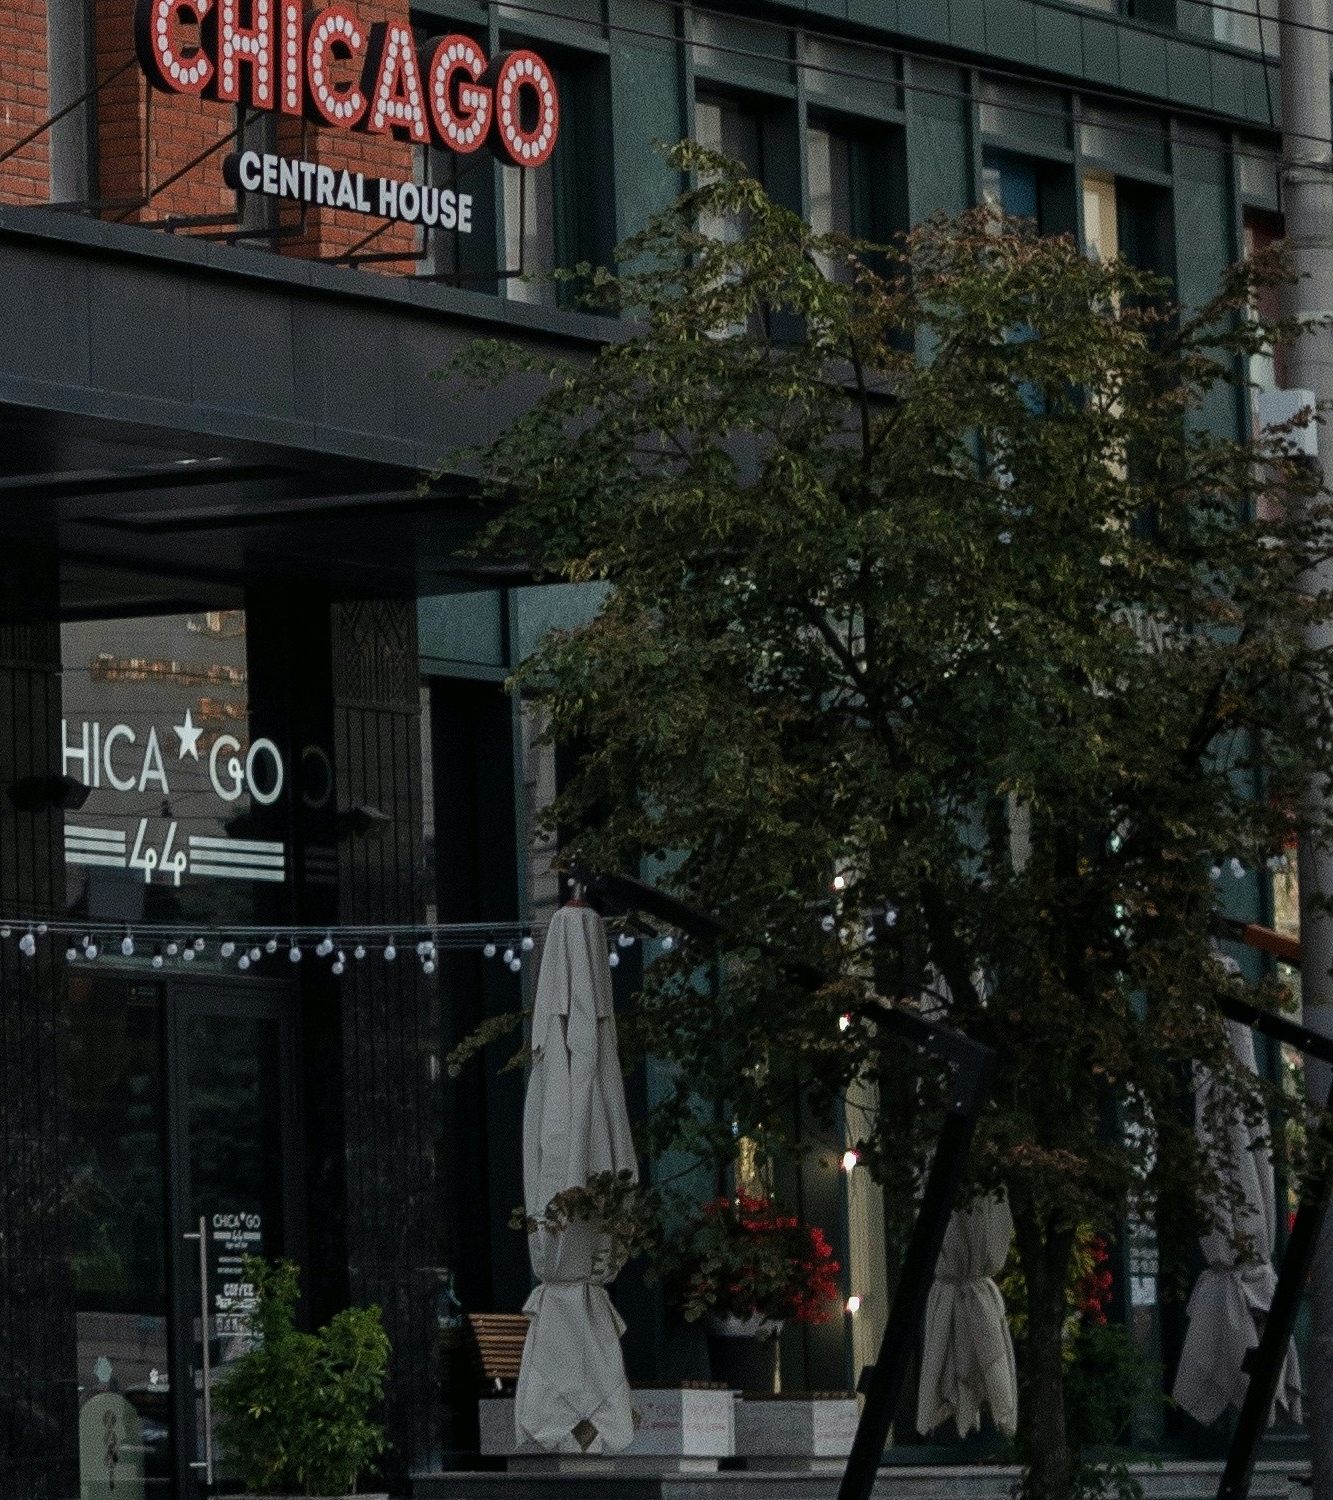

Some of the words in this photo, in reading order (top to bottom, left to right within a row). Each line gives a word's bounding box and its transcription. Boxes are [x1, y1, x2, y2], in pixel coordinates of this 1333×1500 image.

[238, 150, 372, 214] CENTRAL
[378, 177, 474, 234] HOUSE
[128, 817, 188, 887] 44
